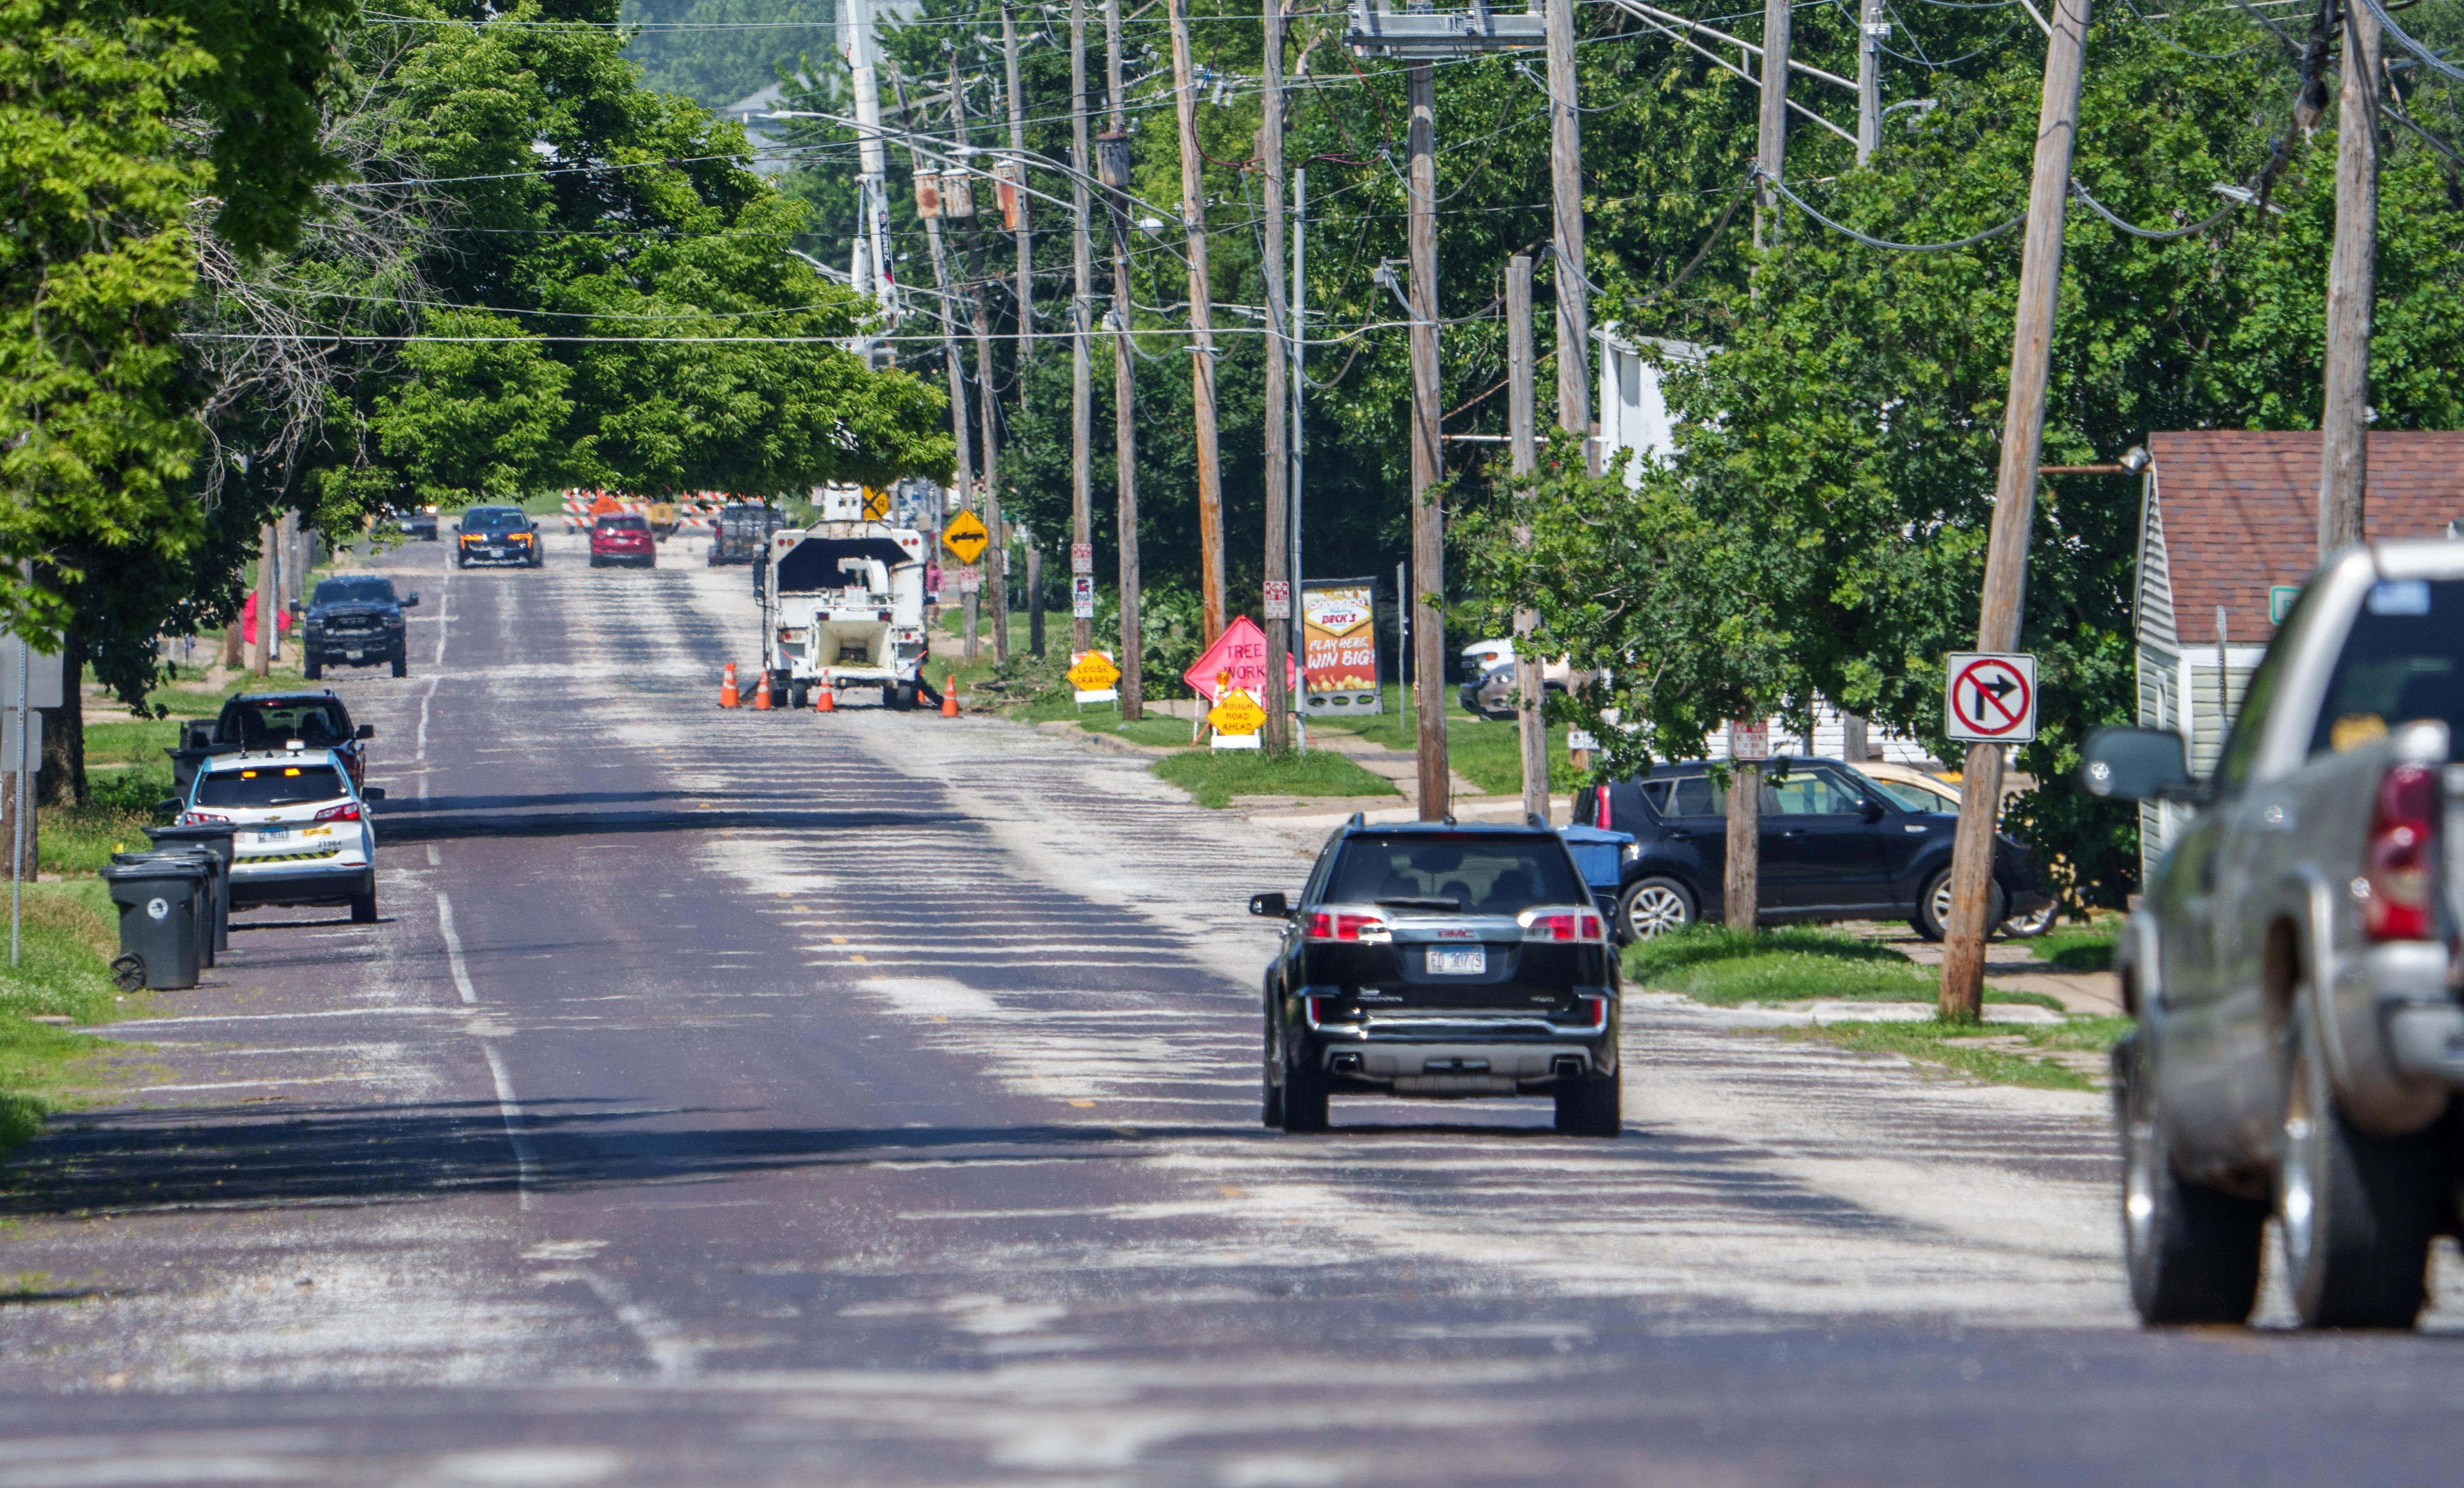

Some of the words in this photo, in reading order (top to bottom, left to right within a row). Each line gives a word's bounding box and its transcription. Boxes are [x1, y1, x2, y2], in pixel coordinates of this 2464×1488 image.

[1227, 643, 1262, 659] TREE
[1309, 639, 1338, 653] PLAY
[1308, 653, 1338, 669] WIN
[1342, 650, 1375, 666] BIG!
[1224, 664, 1266, 679] WORK
[1223, 702, 1253, 711] ROUGH
[1226, 713, 1250, 721] ROAD
[1223, 723, 1252, 731] AHEAD
[1438, 929, 1474, 938] GMC
[1451, 952, 1482, 968] 30779
